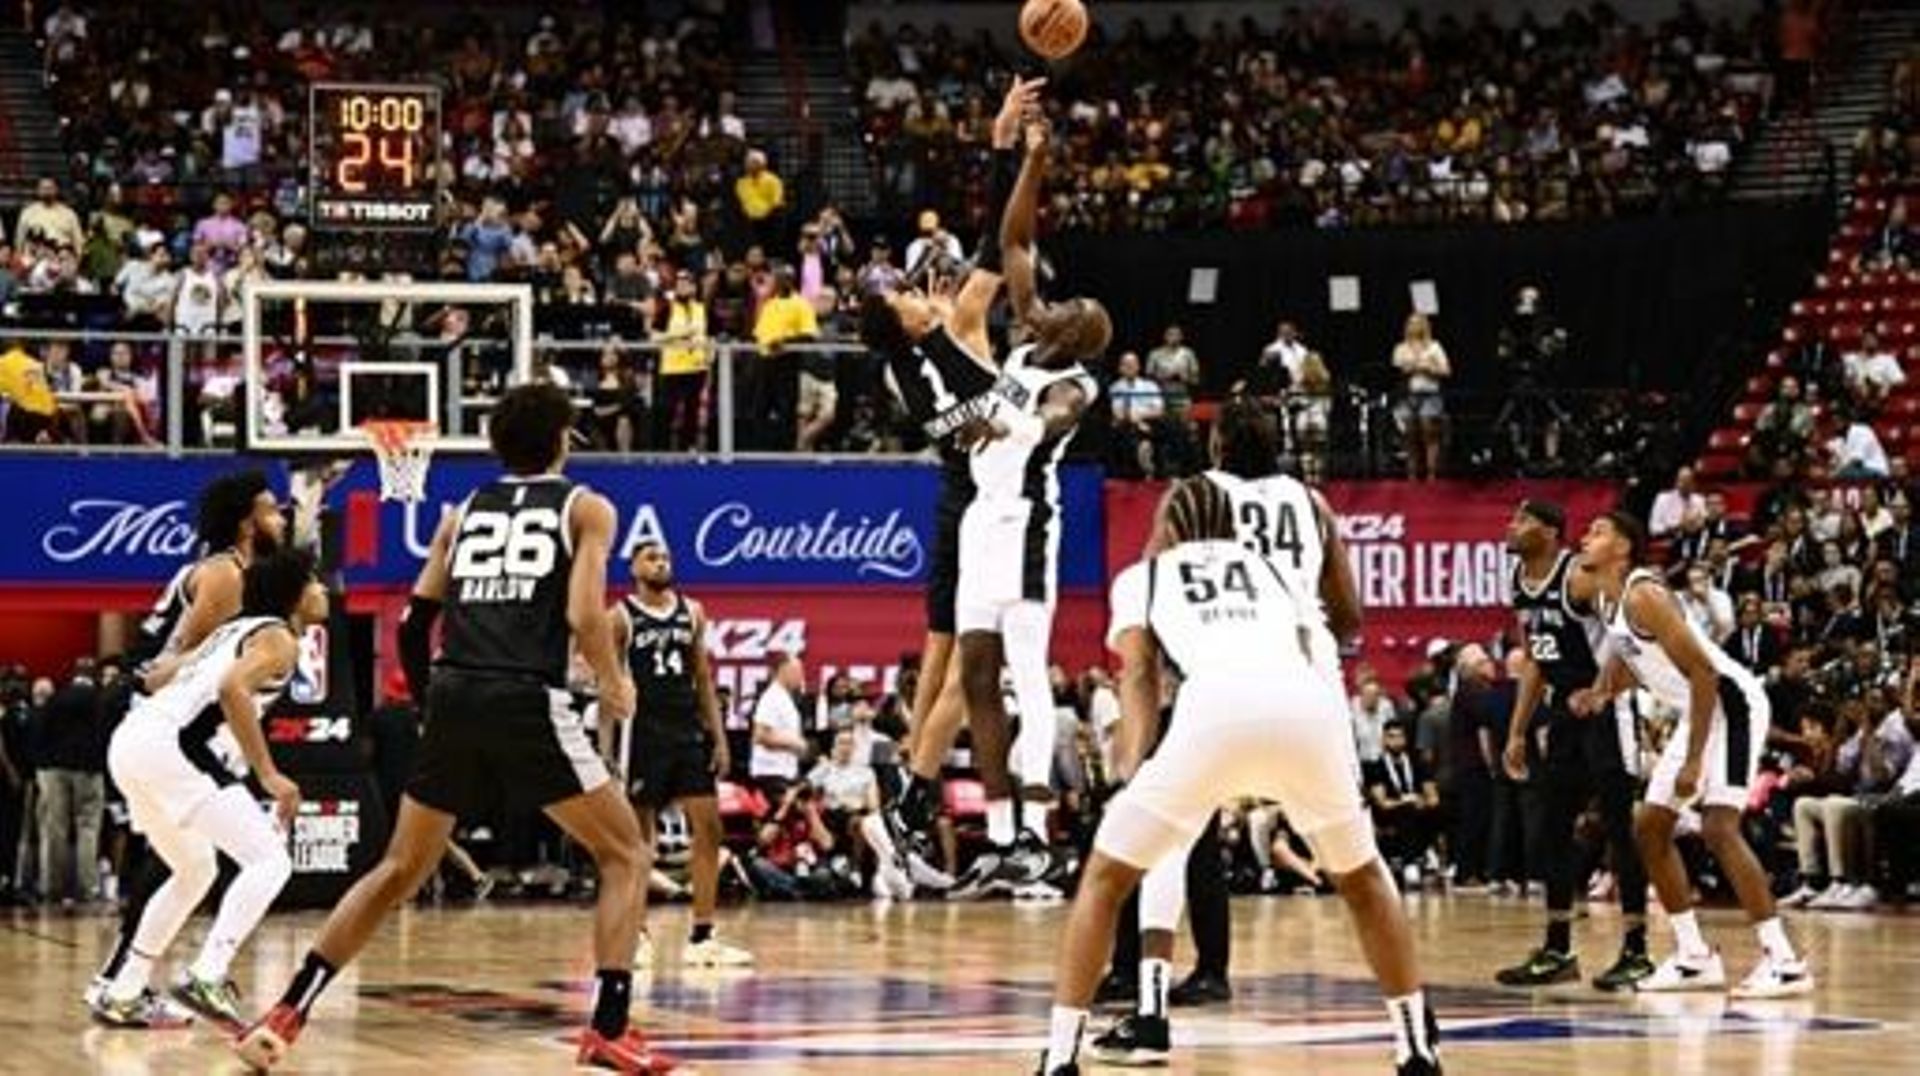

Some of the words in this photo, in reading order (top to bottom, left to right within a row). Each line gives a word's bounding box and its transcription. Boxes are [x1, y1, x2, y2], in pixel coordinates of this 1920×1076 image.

[341, 96, 423, 131] 10:00
[339, 133, 412, 192] 24
[350, 203, 433, 220] TISSOT
[920, 358, 957, 412] 1
[453, 508, 558, 578] 26
[696, 502, 923, 577] Courtside
[1240, 501, 1304, 569] 34
[1179, 559, 1259, 604] 54
[654, 650, 683, 675] 14
[1529, 632, 1561, 661] 22
[268, 716, 350, 743] 2K24
